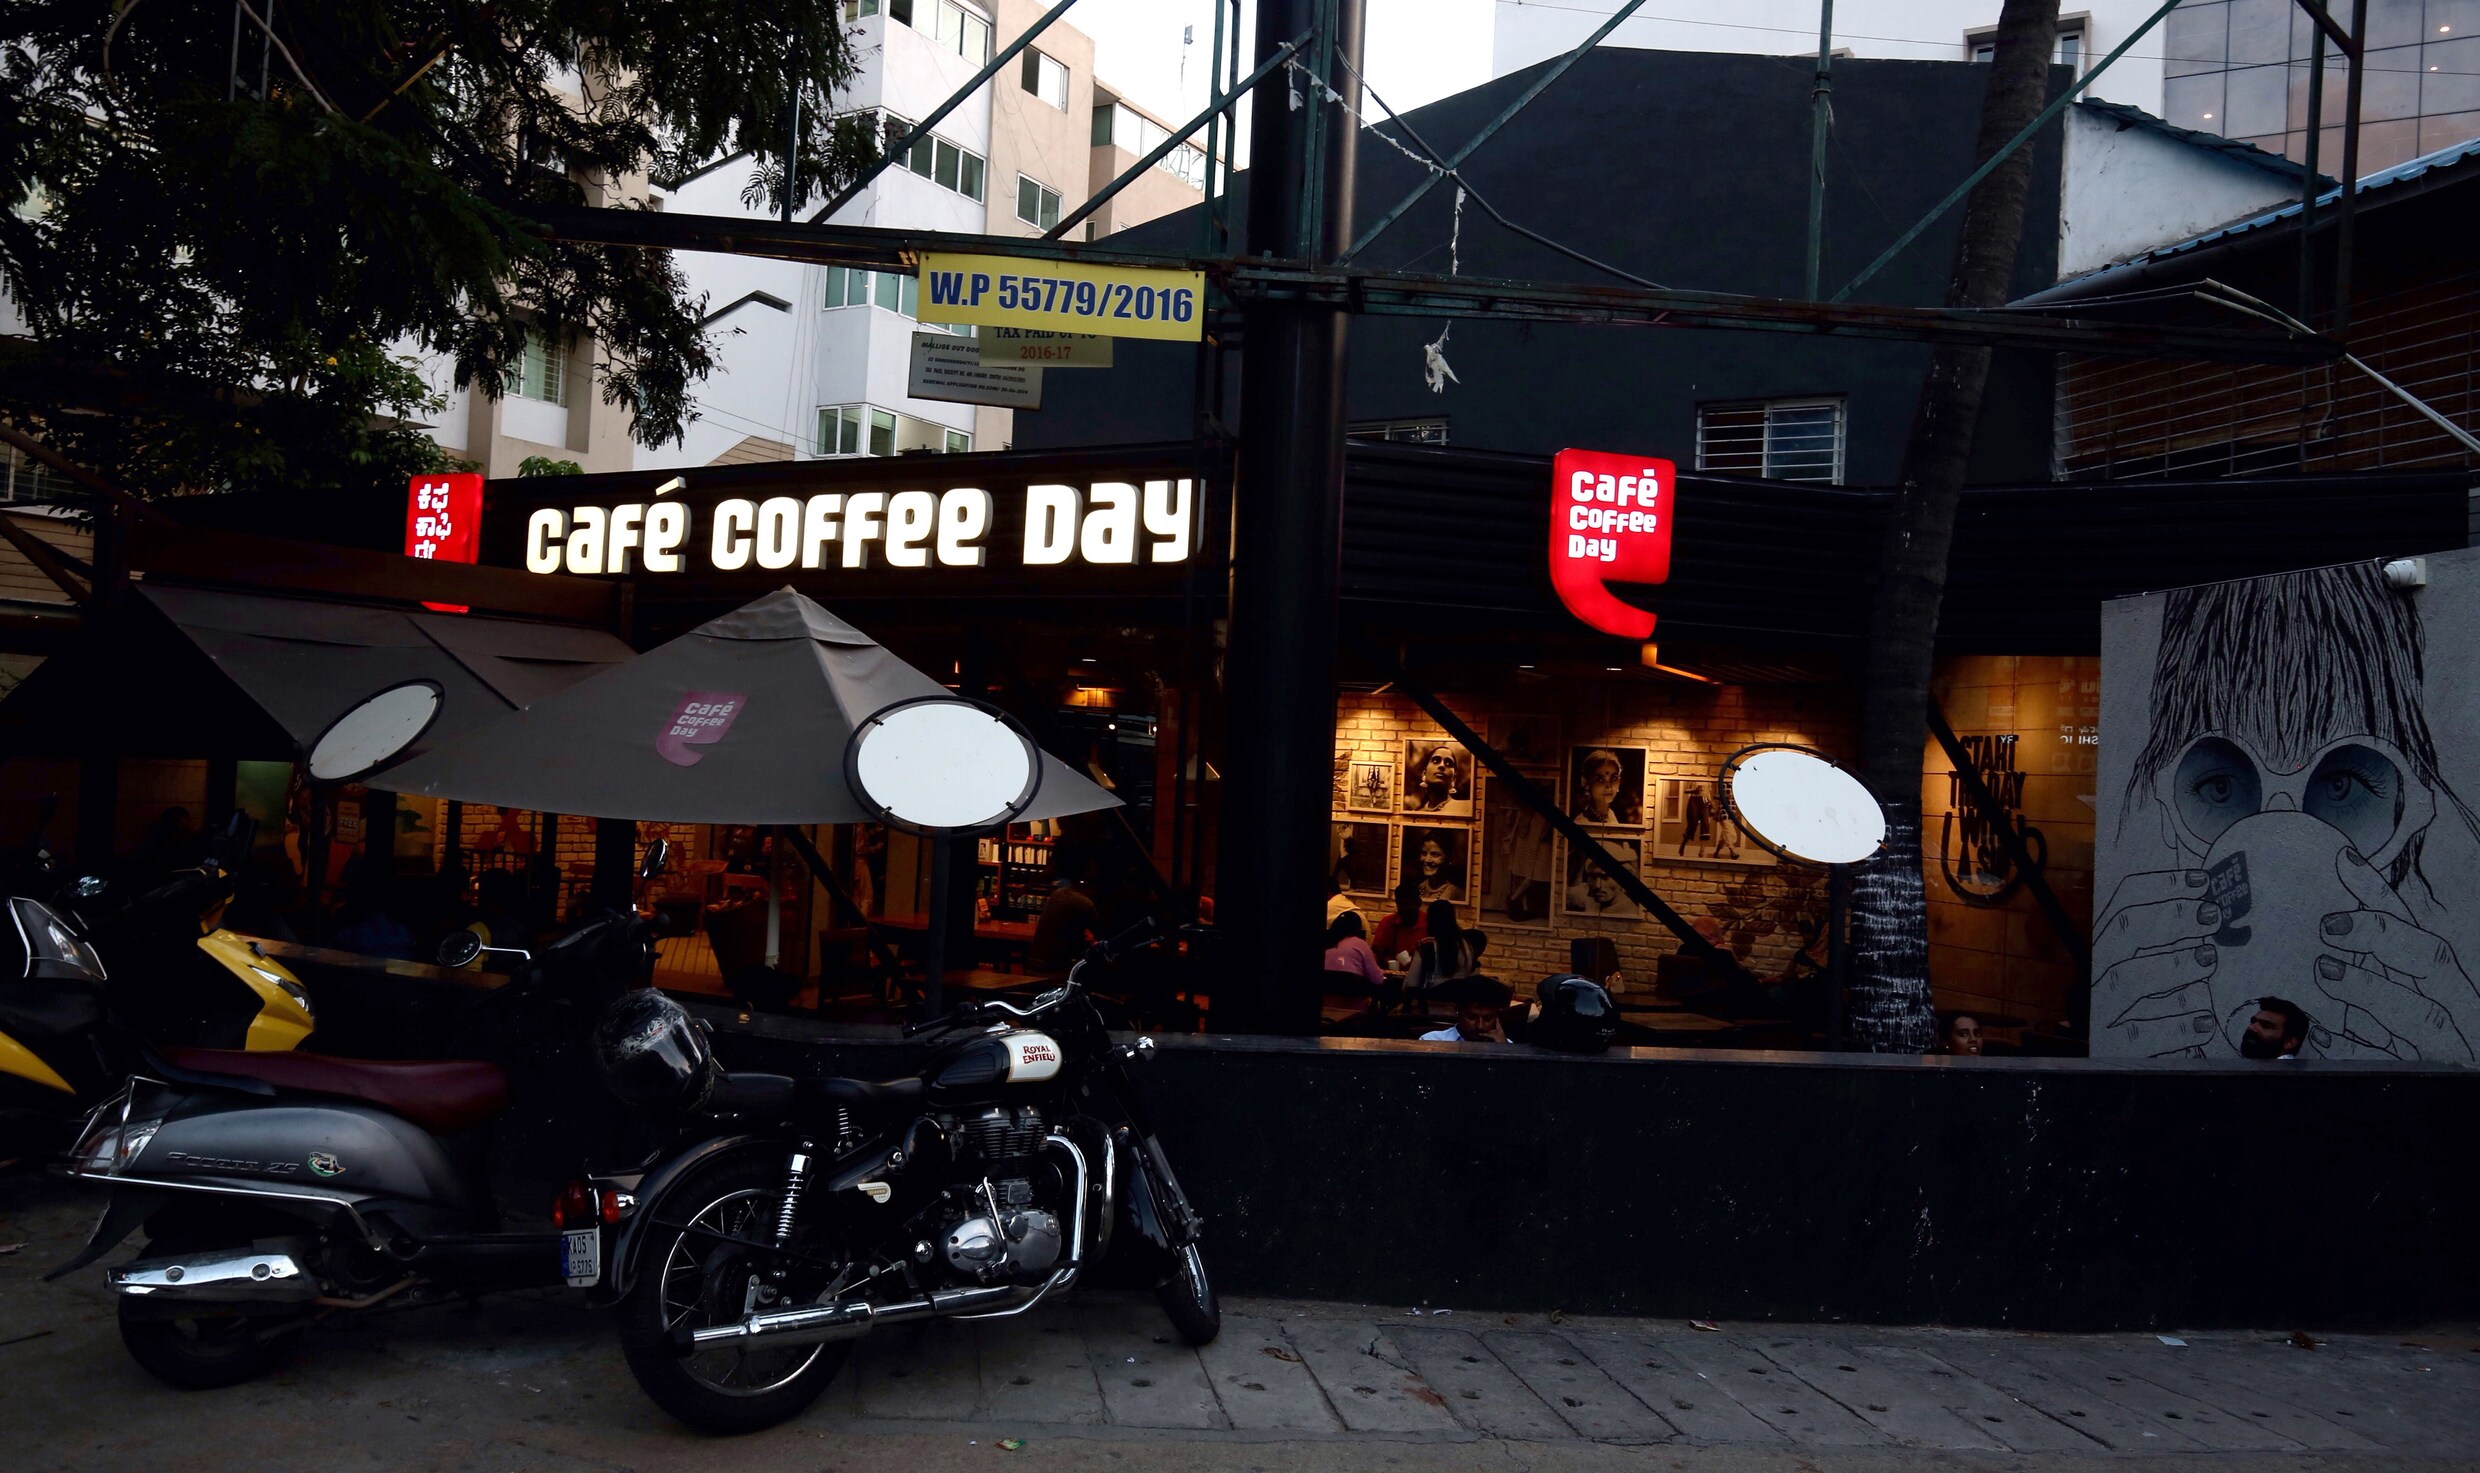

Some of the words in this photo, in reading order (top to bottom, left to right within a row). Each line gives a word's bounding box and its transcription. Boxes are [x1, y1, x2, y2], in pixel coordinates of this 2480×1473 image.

[929, 271, 990, 307] W.P
[998, 275, 1193, 323] 55779/2016
[994, 327, 1021, 338] TAX
[1021, 346, 1071, 359] 2016-17
[1022, 478, 1200, 567] Day
[1568, 534, 1617, 562] Day
[669, 725, 699, 738] Day
[1023, 1045, 1051, 1054] ROYAL
[1023, 1053, 1055, 1064] ENFIELD
[568, 1236, 587, 1255] KA05
